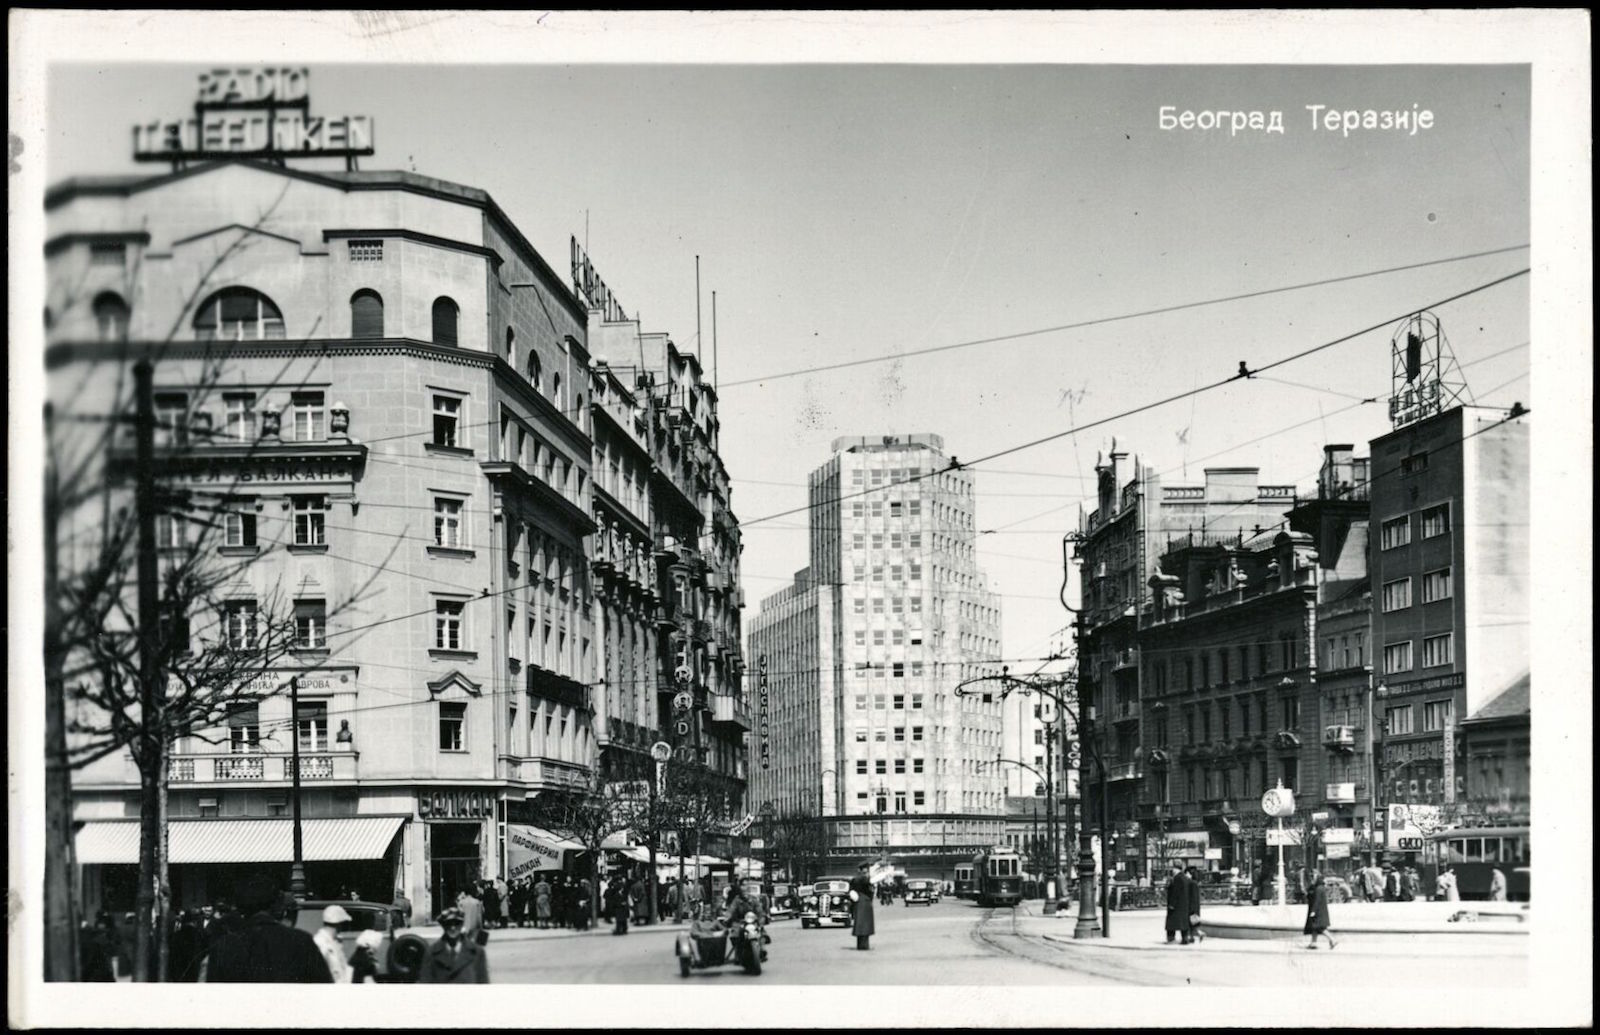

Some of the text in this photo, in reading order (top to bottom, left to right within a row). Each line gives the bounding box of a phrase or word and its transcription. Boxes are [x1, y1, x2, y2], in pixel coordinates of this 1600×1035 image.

[198, 68, 308, 102] RADIO
[133, 116, 373, 152] TELEFUNKEN
[240, 466, 332, 482] БАЛКАН
[511, 834, 559, 860] ПАРФИМЕРИЈА
